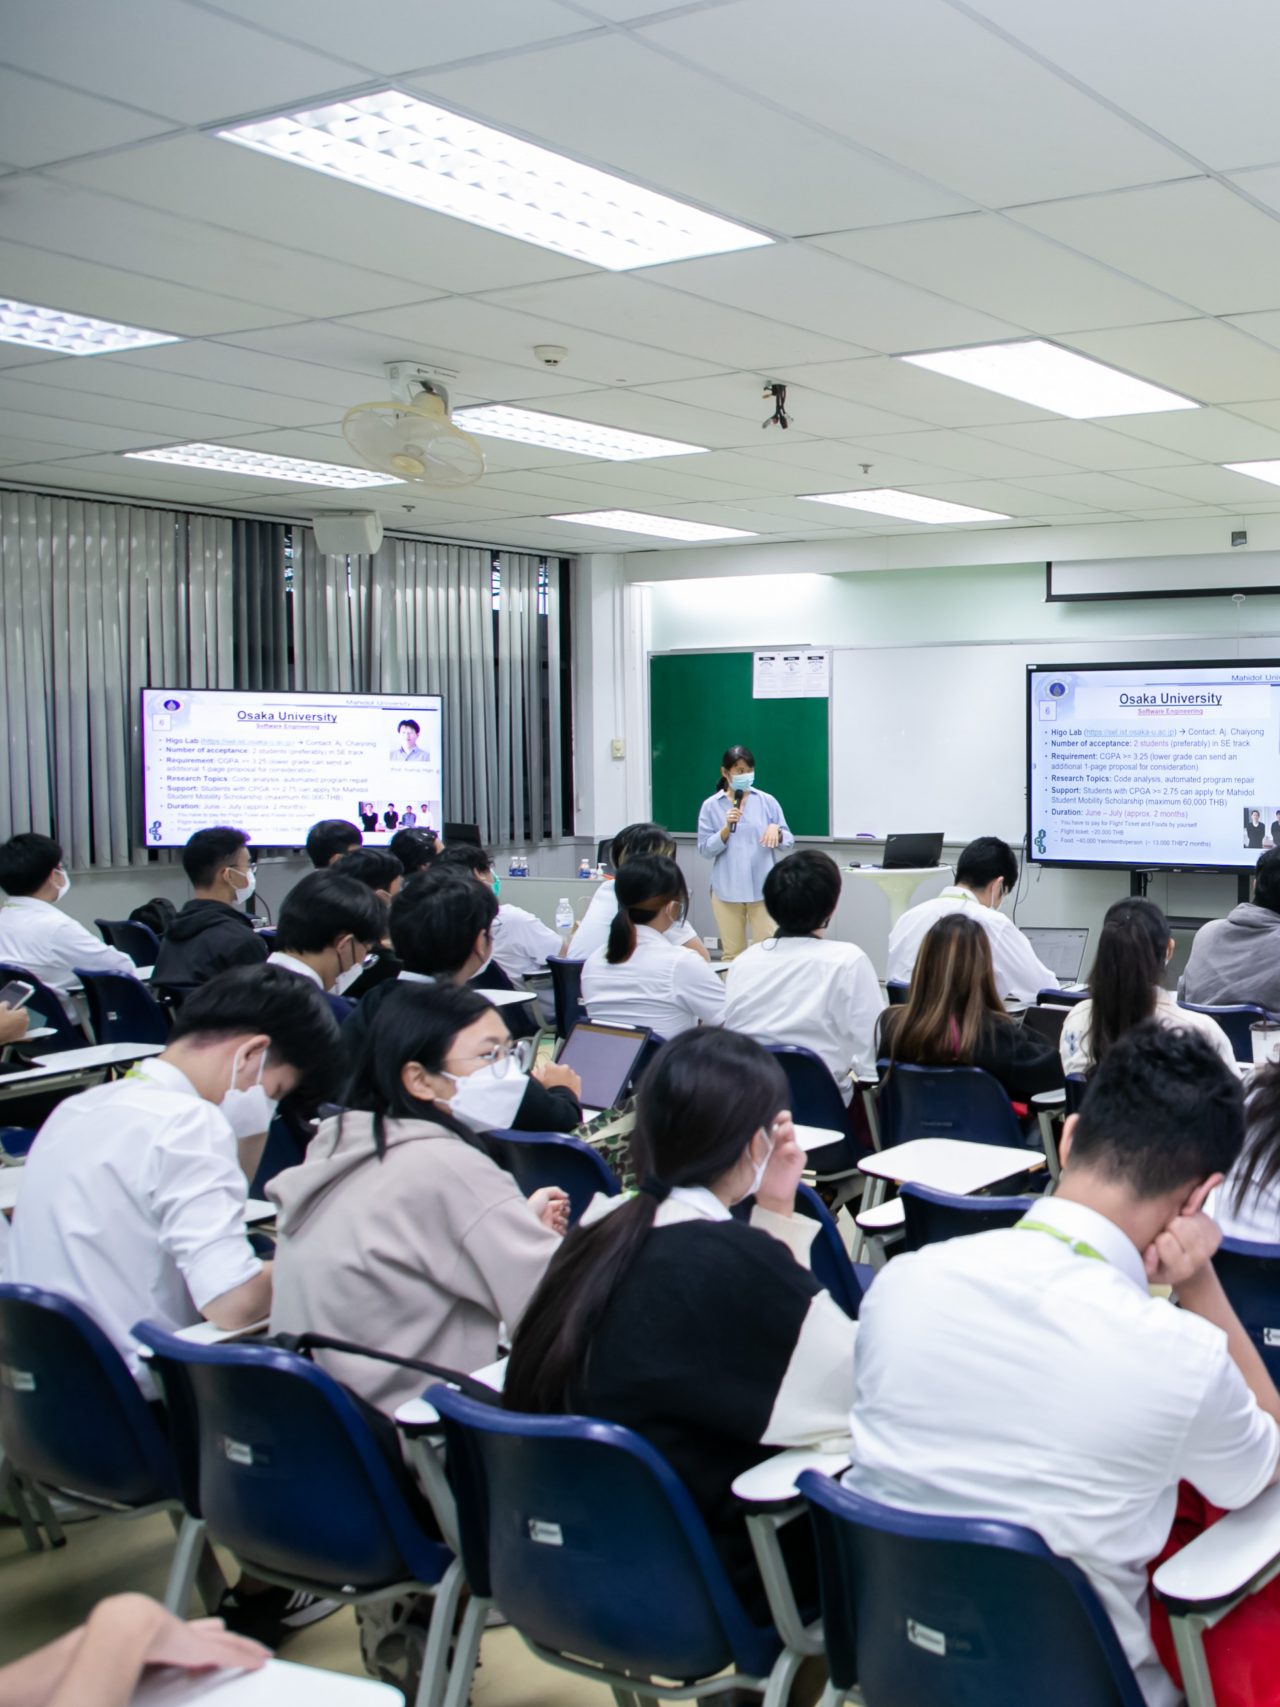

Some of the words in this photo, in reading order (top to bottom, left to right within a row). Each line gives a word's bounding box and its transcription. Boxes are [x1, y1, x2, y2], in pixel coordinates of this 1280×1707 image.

[1119, 693, 1157, 705] Osaka
[1160, 691, 1222, 706] University
[237, 710, 275, 721] Osaka
[278, 711, 338, 723] University
[1051, 729, 1067, 738] Higo
[1051, 774, 1084, 782] Research
[1086, 774, 1112, 783] Topics:
[1051, 808, 1083, 816] Duration:
